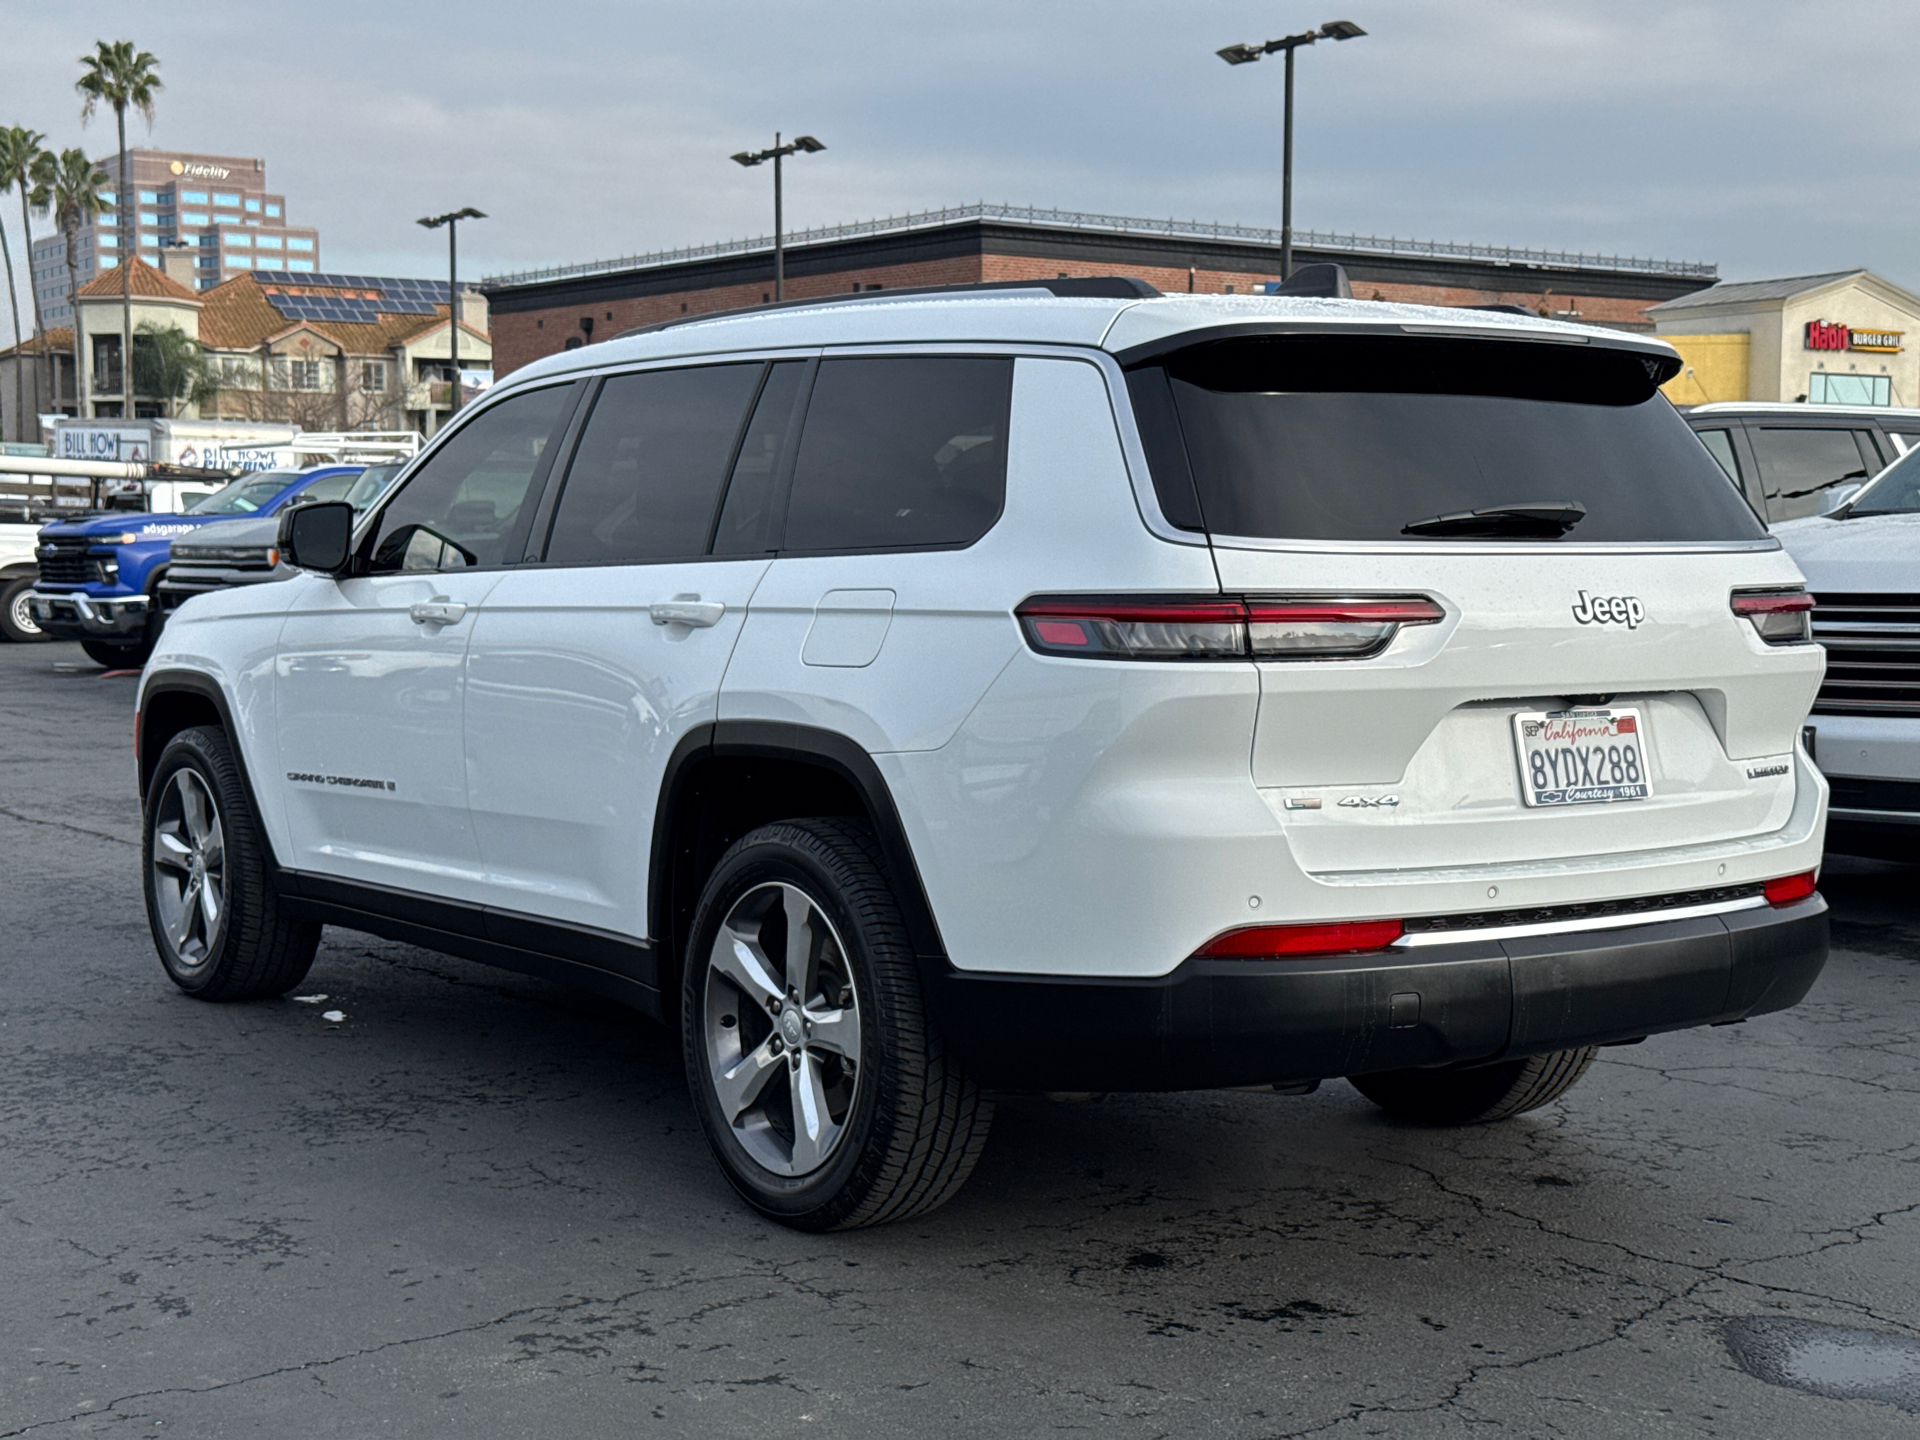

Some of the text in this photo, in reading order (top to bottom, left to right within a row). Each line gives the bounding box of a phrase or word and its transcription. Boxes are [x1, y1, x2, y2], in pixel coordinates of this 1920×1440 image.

[184, 163, 230, 180] Fidelity
[1806, 320, 1849, 351] Habit
[1852, 333, 1882, 346] BURGER
[65, 432, 120, 455] BILL HOW
[203, 446, 230, 461] BILL
[1571, 590, 1645, 629] Jeep
[1525, 725, 1540, 737] SEP
[1544, 719, 1618, 746] California
[1530, 744, 1640, 790] 8YDX288
[1565, 785, 1641, 803] Courtesy 1961
